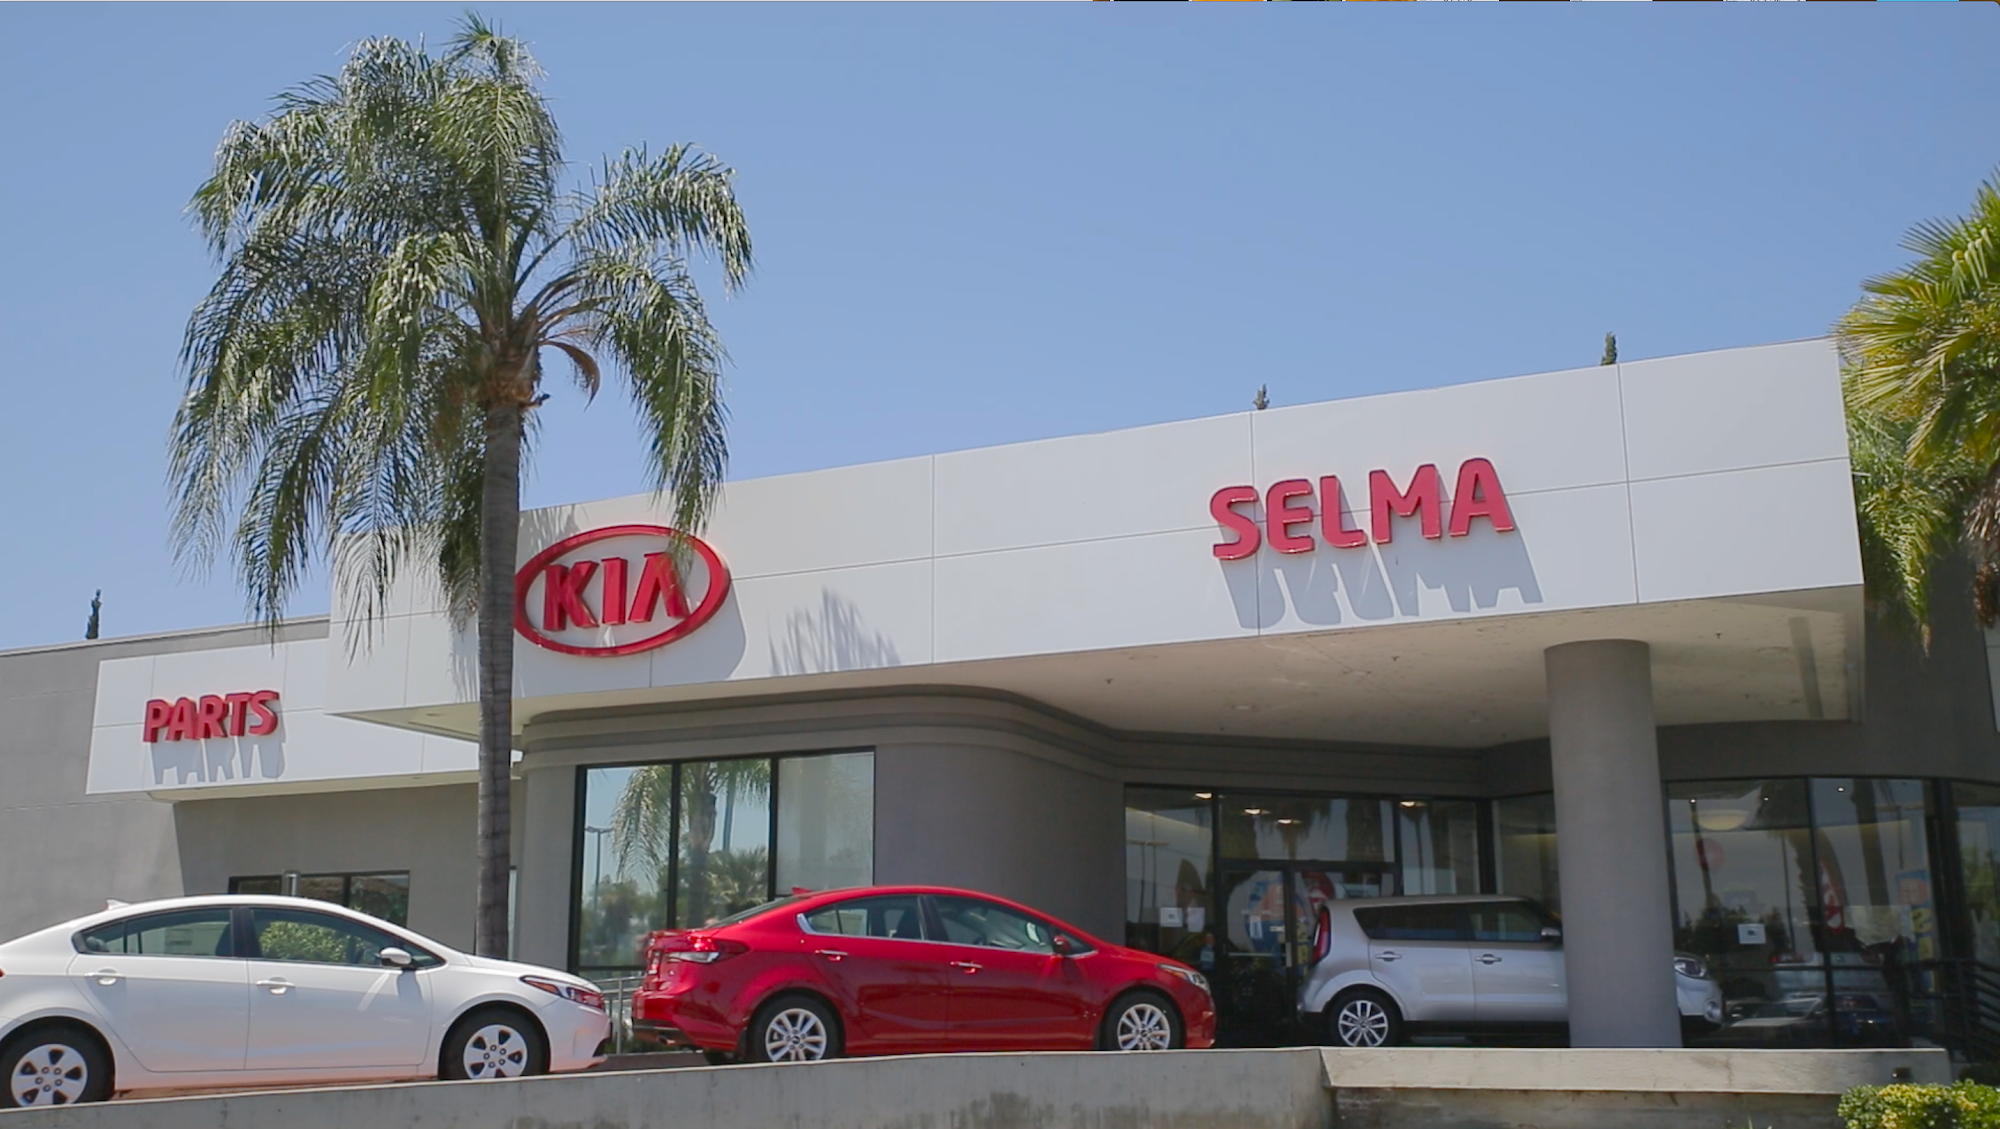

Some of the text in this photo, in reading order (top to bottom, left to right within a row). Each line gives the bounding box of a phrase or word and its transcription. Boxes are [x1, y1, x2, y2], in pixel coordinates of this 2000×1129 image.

[1210, 457, 1515, 561] SELMA
[543, 551, 691, 632] KIA
[143, 690, 280, 743] PARTS
